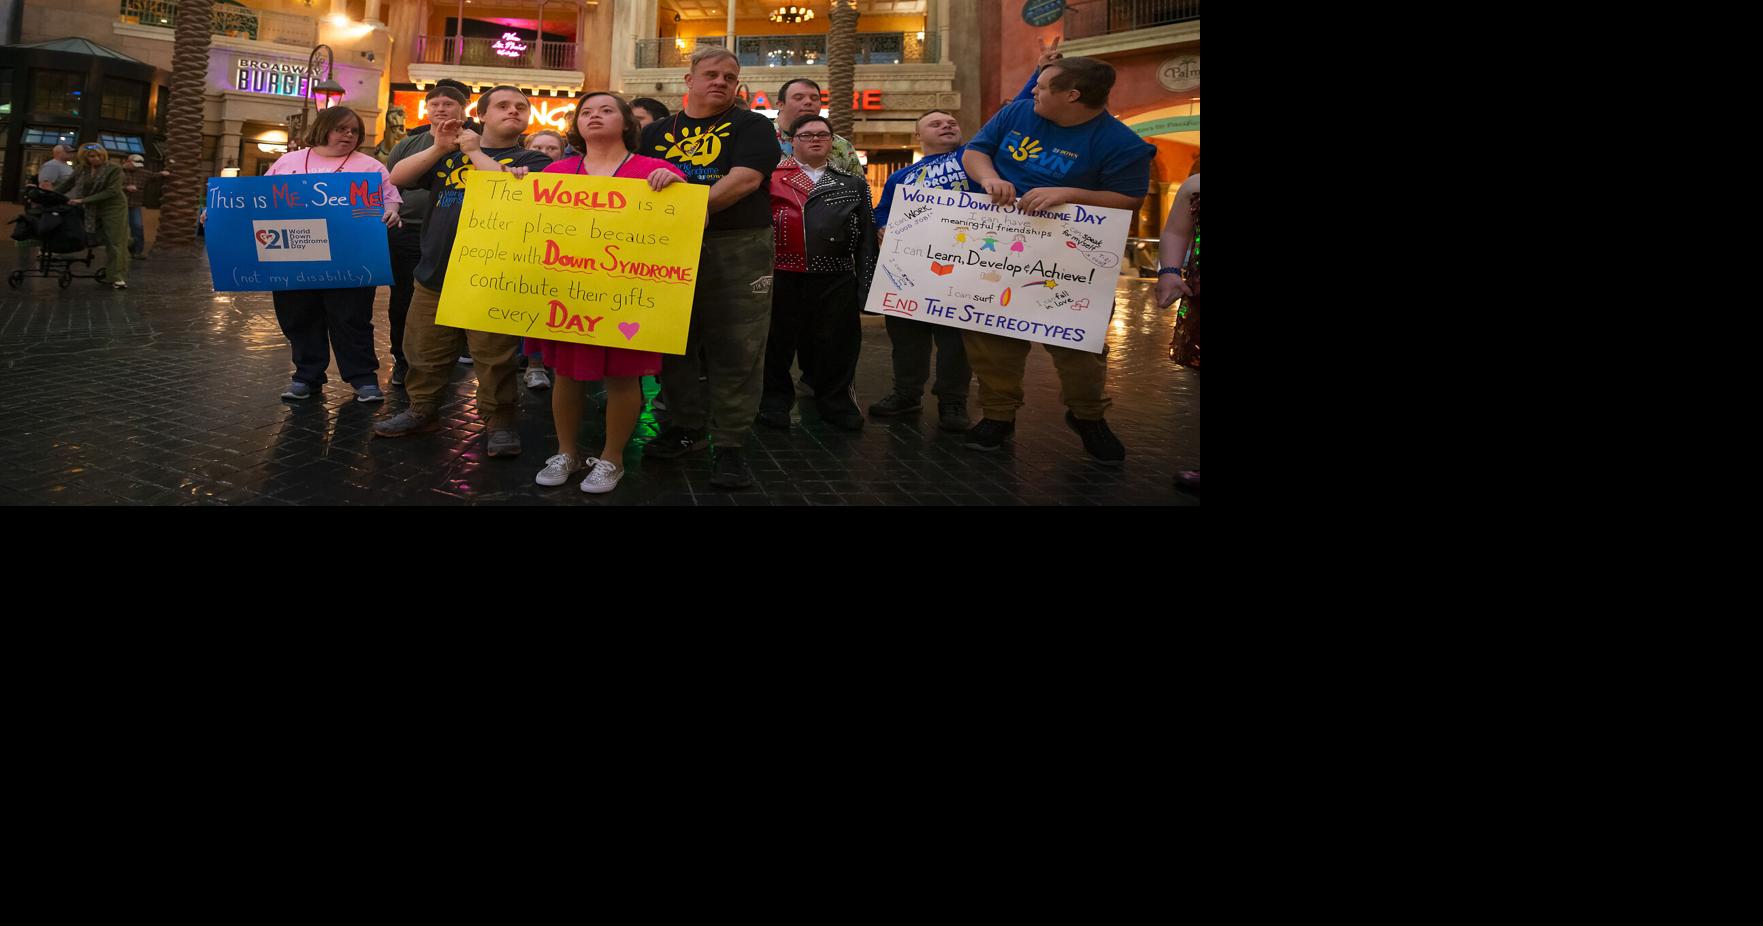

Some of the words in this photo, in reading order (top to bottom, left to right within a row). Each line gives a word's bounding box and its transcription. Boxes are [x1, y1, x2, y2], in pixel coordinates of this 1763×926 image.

[253, 192, 267, 209] is
[311, 182, 349, 206] See
[487, 179, 523, 201] The
[533, 179, 627, 209] WORLD
[638, 200, 653, 211] is
[664, 204, 675, 216] a
[902, 187, 955, 206] WORLD
[1074, 205, 1107, 225] DAY
[904, 205, 932, 220] WORK
[468, 209, 512, 231] better
[523, 212, 577, 243] place
[590, 218, 670, 245] because
[941, 217, 994, 230] meaningful
[997, 224, 1052, 238] friendships
[459, 241, 508, 265] people
[513, 245, 542, 265] with
[543, 239, 598, 271] Down
[600, 245, 693, 282] SYNDROME
[904, 246, 923, 257] can
[927, 244, 965, 265] Learn,
[966, 249, 1022, 277] Develop
[1029, 259, 1096, 285] Achieve!
[270, 274, 290, 287] my
[470, 271, 559, 297] contribute
[568, 281, 608, 302] their
[611, 287, 655, 311] gifts
[488, 305, 540, 333] every
[545, 299, 604, 333] DAY
[882, 292, 918, 312] END
[924, 298, 957, 319] THE
[958, 304, 1086, 342] STEREOTYPES
[973, 294, 996, 304] surf
